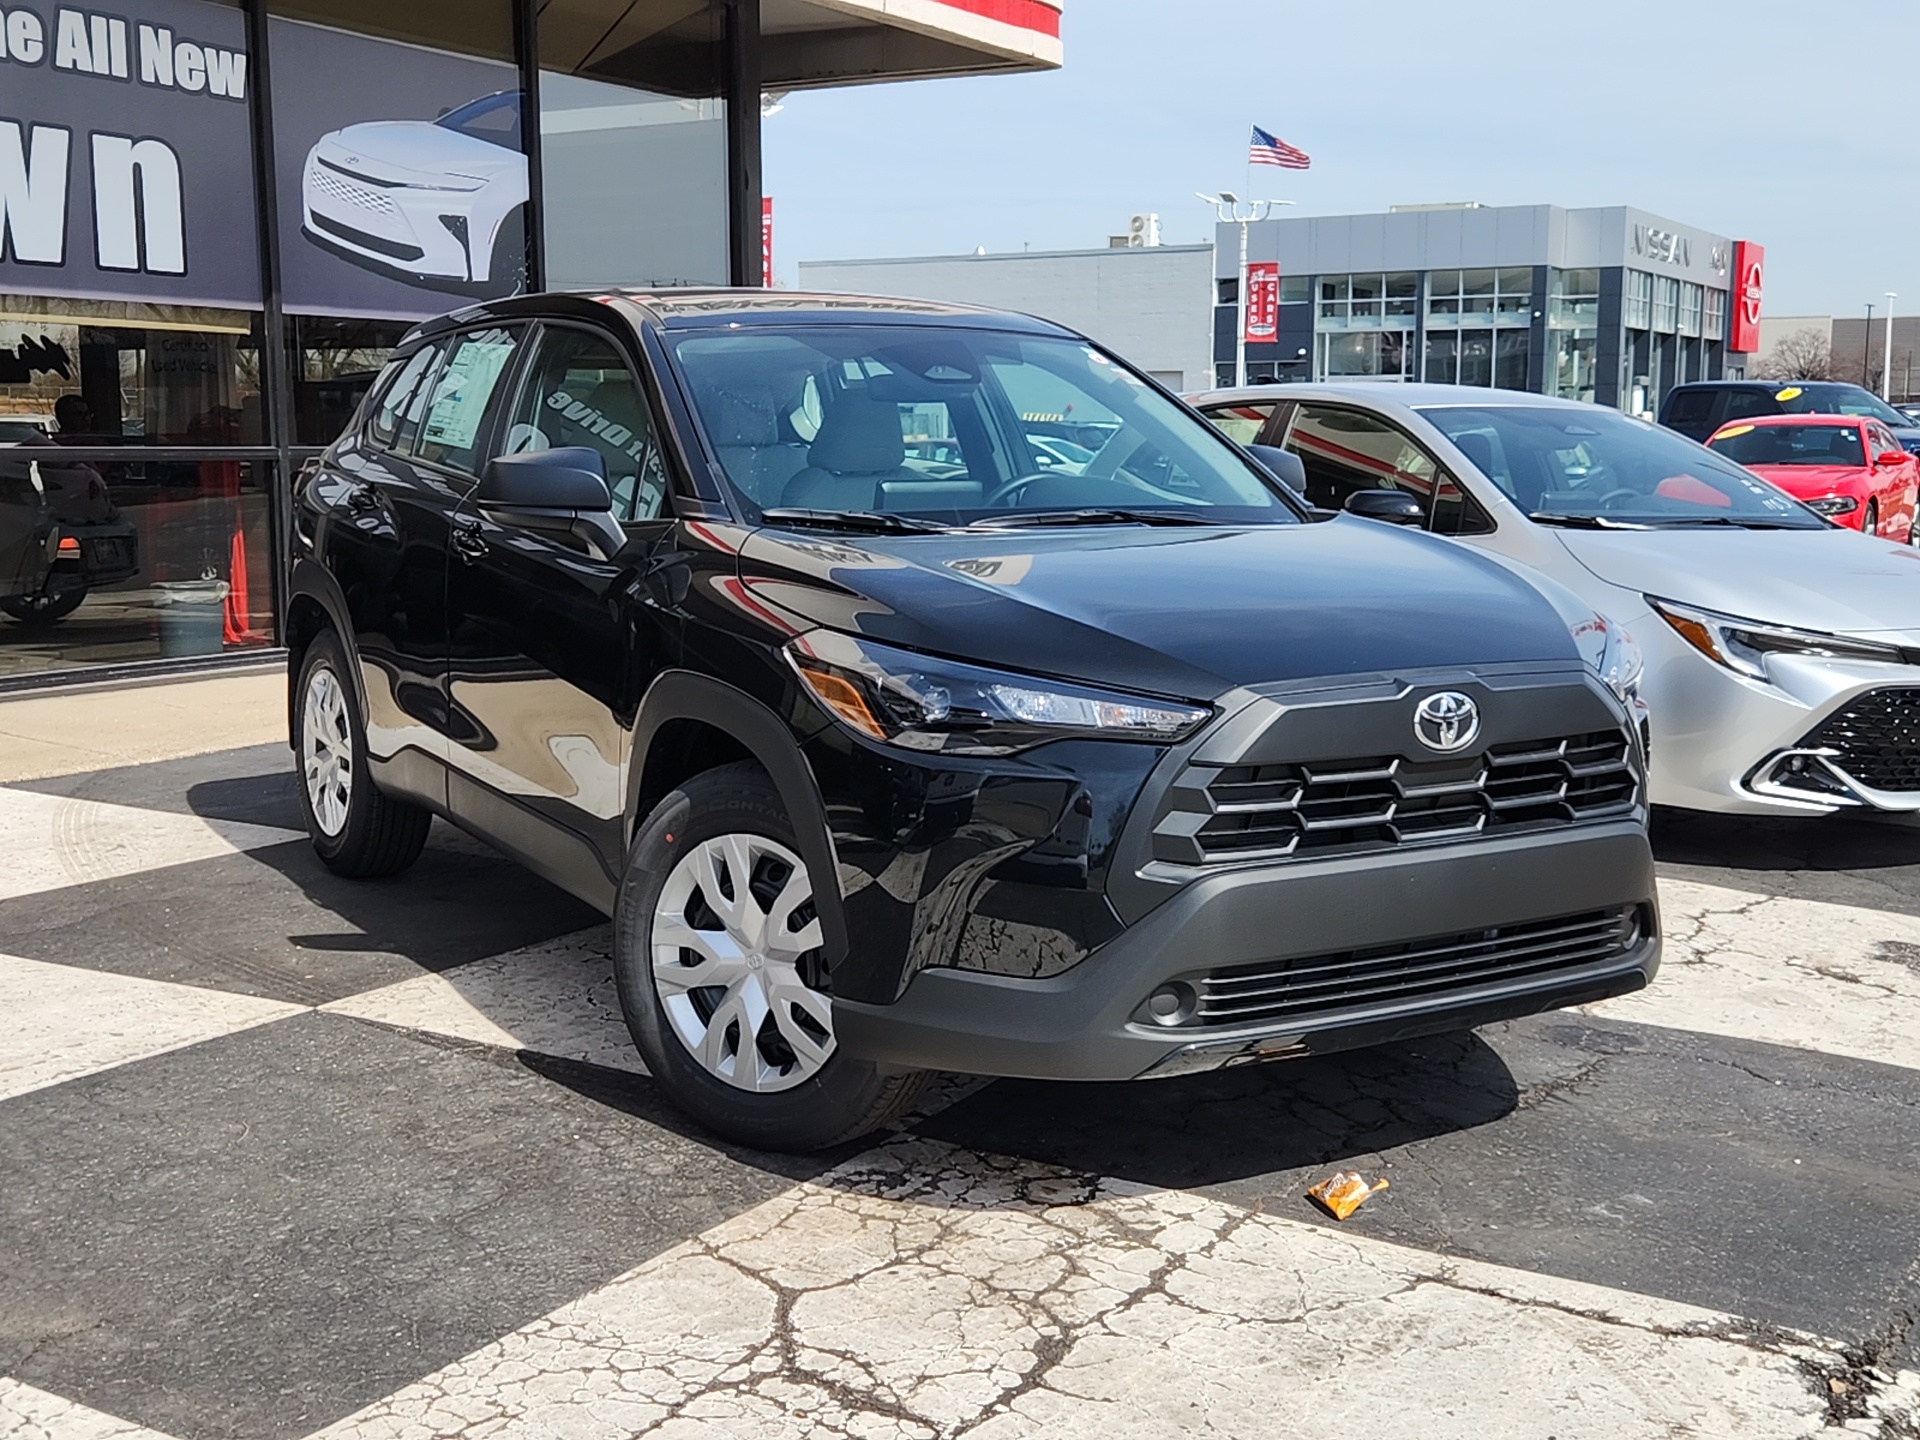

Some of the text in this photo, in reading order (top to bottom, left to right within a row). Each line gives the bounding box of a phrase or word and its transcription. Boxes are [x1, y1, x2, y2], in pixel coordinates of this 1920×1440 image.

[55, 9, 128, 78] All
[139, 24, 247, 99] New
[1632, 223, 1692, 268] NISSAN
[1250, 283, 1259, 324] USED
[1266, 283, 1275, 324] CARS
